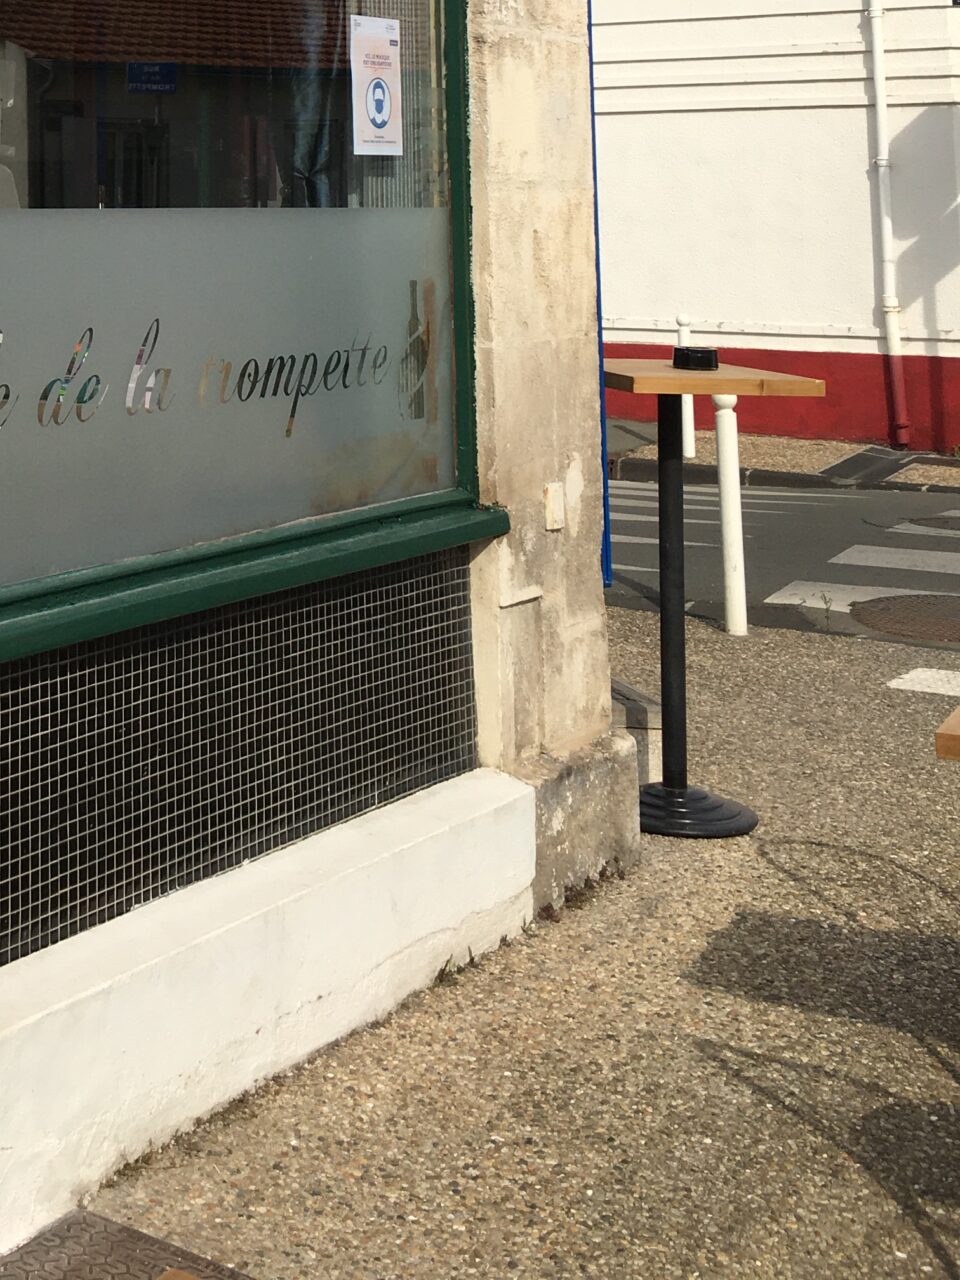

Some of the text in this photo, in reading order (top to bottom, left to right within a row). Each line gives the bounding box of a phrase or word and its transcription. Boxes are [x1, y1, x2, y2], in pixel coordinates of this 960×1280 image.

[37, 327, 109, 428] de
[125, 318, 176, 417] la
[198, 329, 393, 439] trompette
